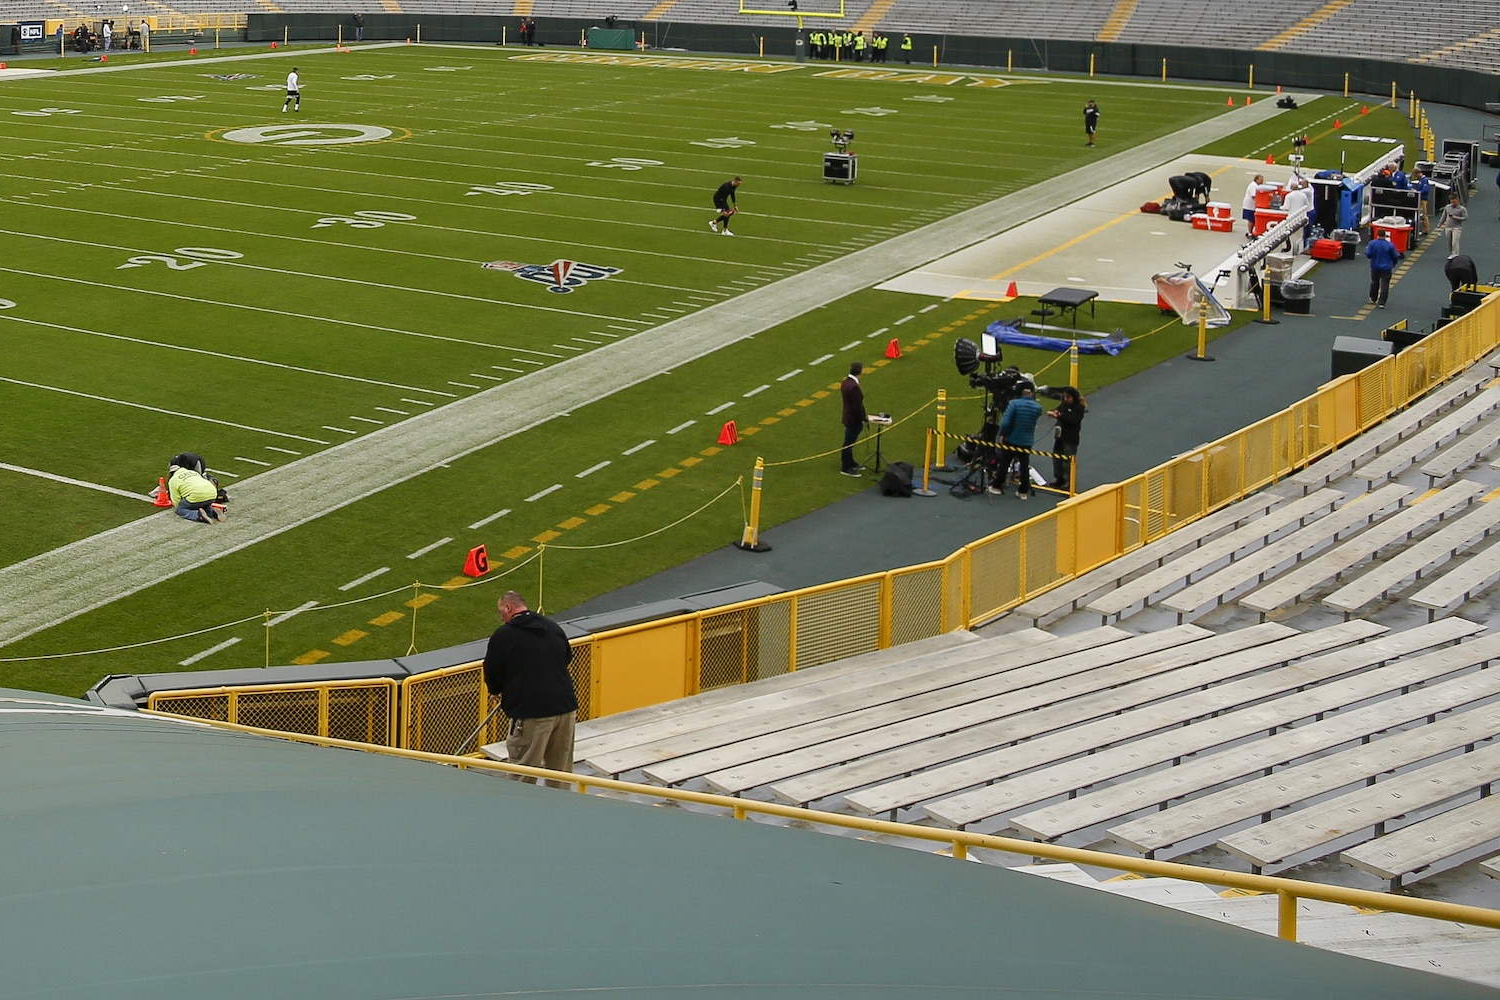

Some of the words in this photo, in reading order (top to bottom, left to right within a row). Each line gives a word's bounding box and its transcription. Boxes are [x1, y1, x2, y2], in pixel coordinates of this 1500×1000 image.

[317, 210, 417, 229] 30
[125, 246, 243, 271] 20
[727, 424, 738, 443] 10
[475, 547, 488, 572] G
